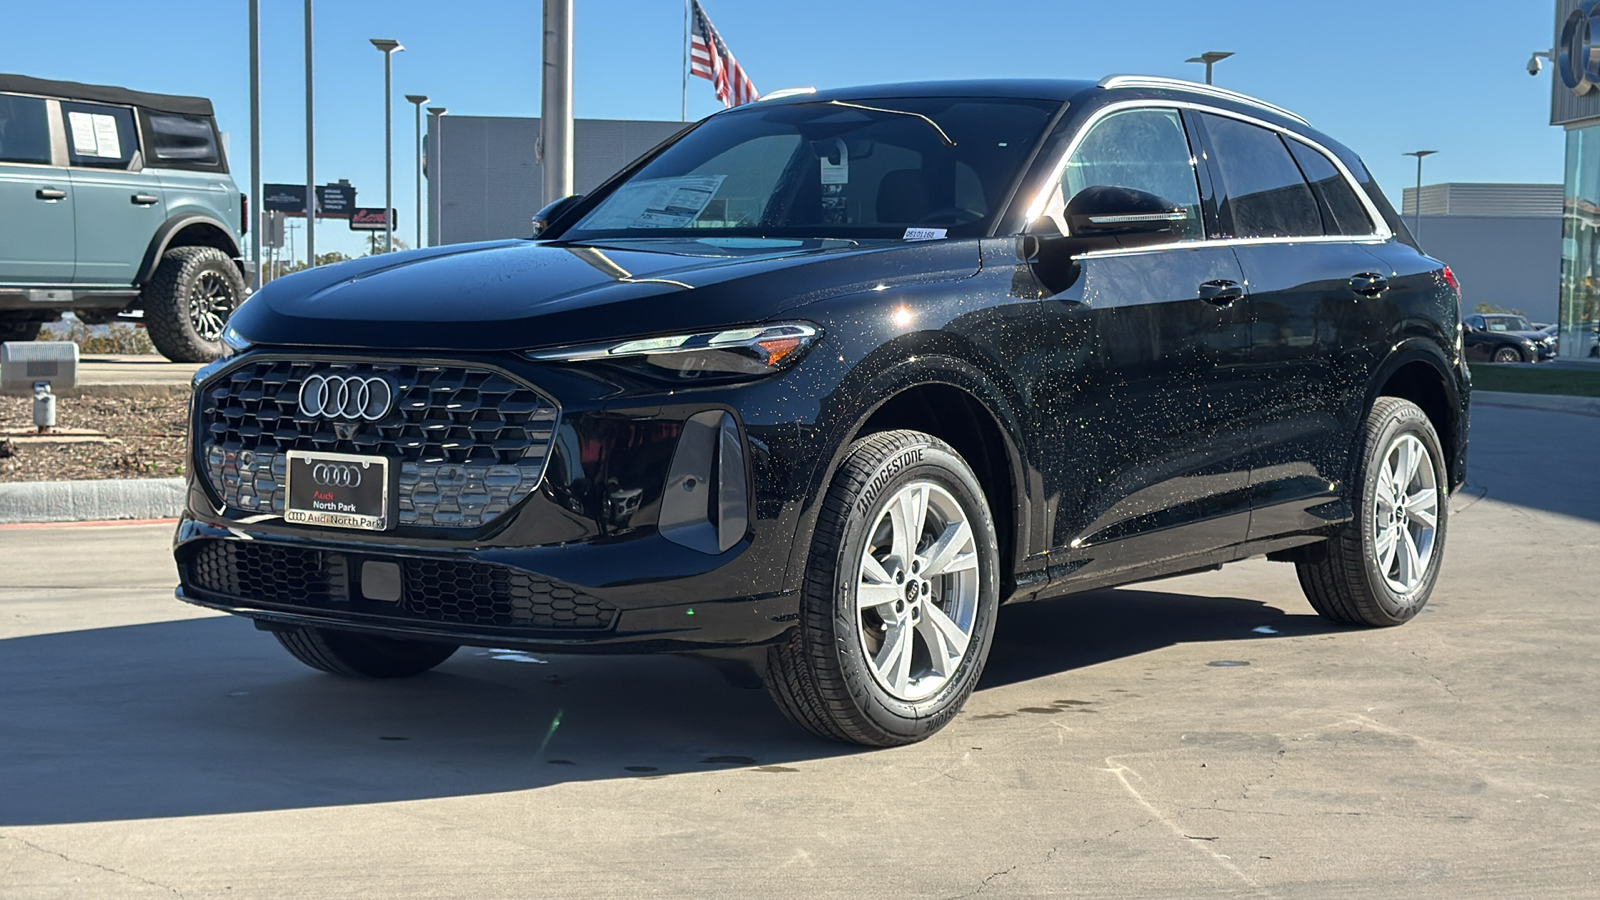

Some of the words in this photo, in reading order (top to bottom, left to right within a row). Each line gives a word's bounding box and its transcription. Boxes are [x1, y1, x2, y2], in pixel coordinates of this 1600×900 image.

[857, 448, 924, 517] BRIDGESTONE
[313, 491, 334, 501] Audi
[313, 501, 337, 511] North
[338, 503, 356, 512] Park
[307, 513, 329, 523] Audi
[330, 515, 360, 527] North
[360, 517, 383, 528] Park
